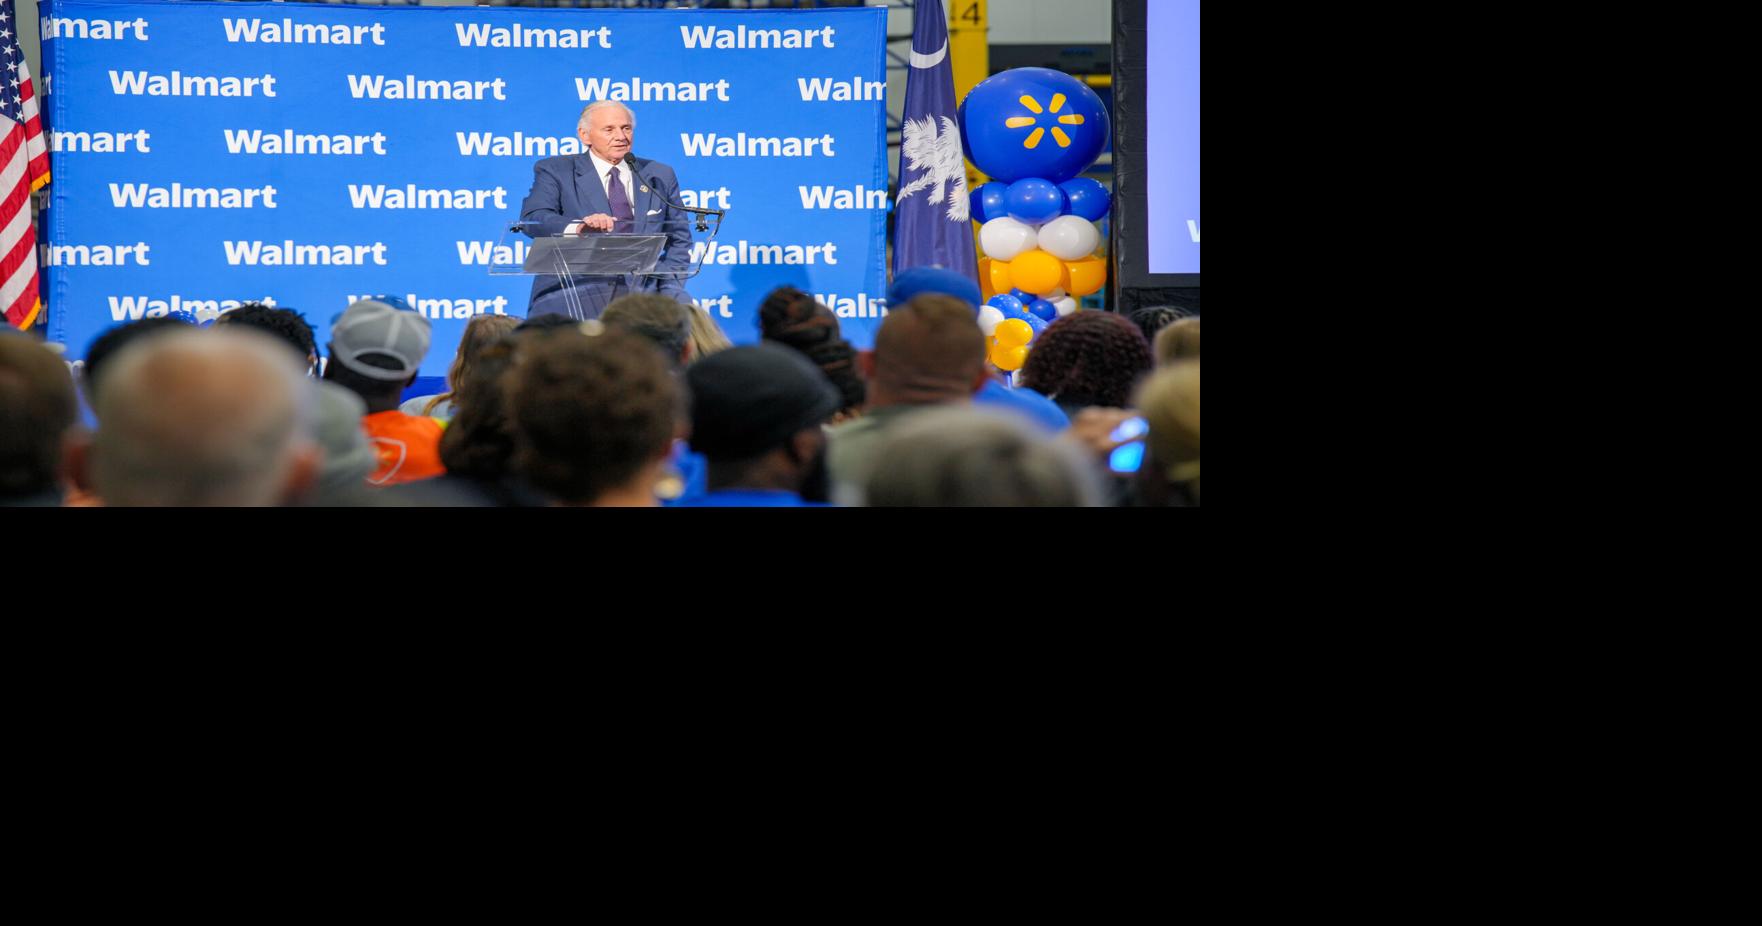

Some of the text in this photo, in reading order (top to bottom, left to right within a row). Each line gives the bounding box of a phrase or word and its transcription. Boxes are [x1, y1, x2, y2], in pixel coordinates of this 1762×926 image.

[223, 18, 385, 46] Walmart
[455, 23, 612, 49] Walmart
[680, 24, 835, 49] Walmart
[108, 70, 277, 98] Walmart
[347, 74, 506, 101] Walmart
[574, 77, 730, 102] Walmart
[223, 129, 387, 155] Walmart
[455, 131, 589, 157] Walma
[680, 132, 835, 157] Walmart
[108, 182, 277, 209] Walmart
[347, 183, 508, 210] Walmart
[223, 239, 387, 266] Walmart
[687, 238, 838, 265] Walmart
